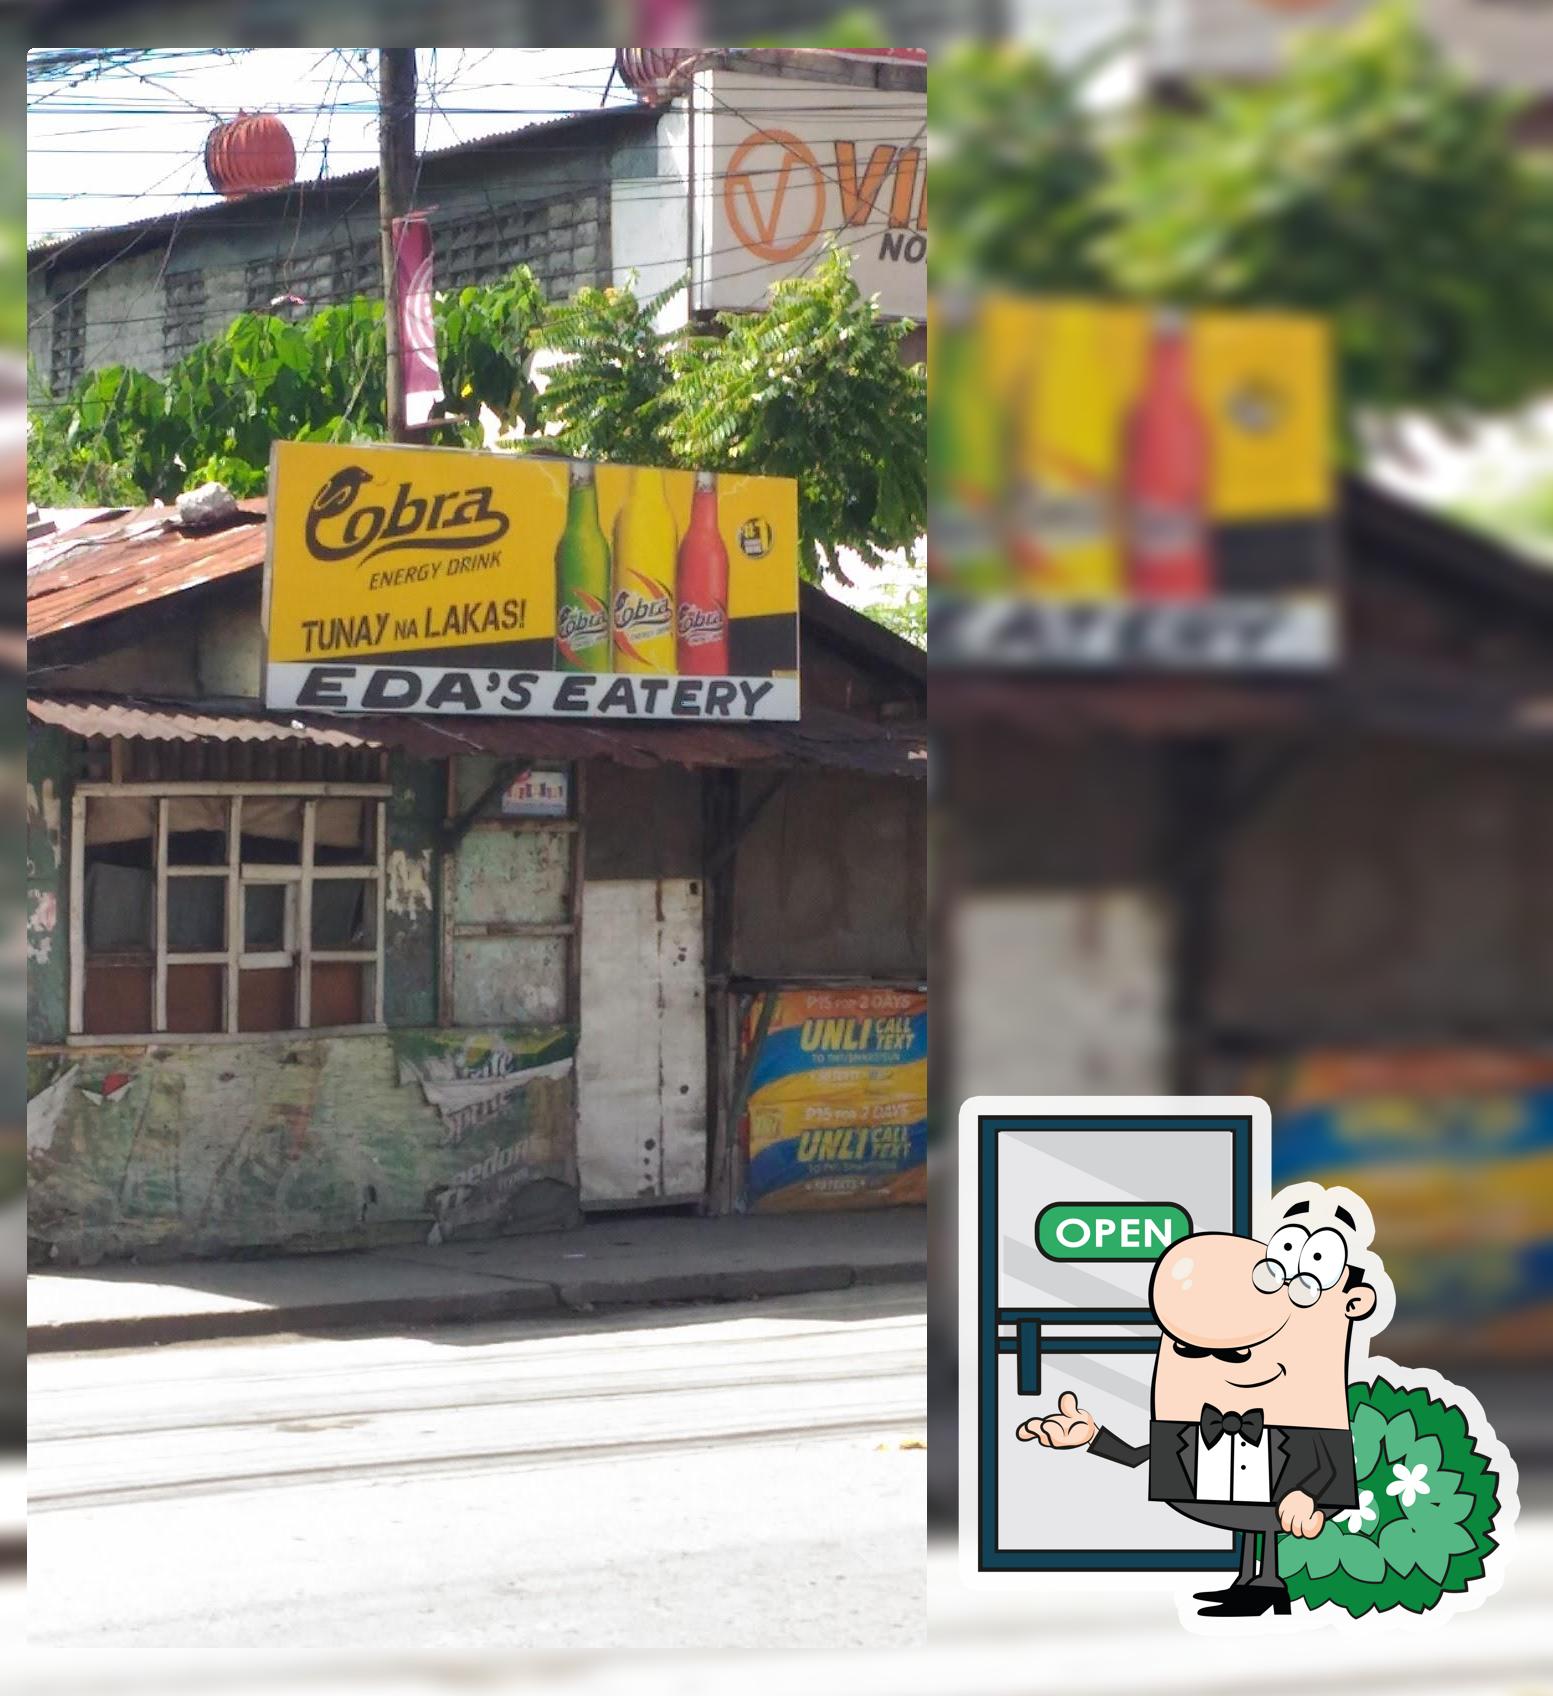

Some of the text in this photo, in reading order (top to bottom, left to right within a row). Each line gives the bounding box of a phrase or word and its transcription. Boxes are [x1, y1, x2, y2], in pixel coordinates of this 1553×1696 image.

[834, 139, 927, 231] VI
[878, 233, 927, 264] NO
[305, 466, 510, 568] Cobra
[368, 550, 502, 591] ENERGY DRINK
[301, 600, 527, 652] TUNAY NA LAKAS!
[296, 667, 774, 717] EDA'S EATERY
[871, 994, 912, 1009] DAYS
[800, 1016, 912, 1052] UNLI CALL
[875, 1033, 915, 1051] TEXT
[797, 1124, 909, 1162] UNLI CALL
